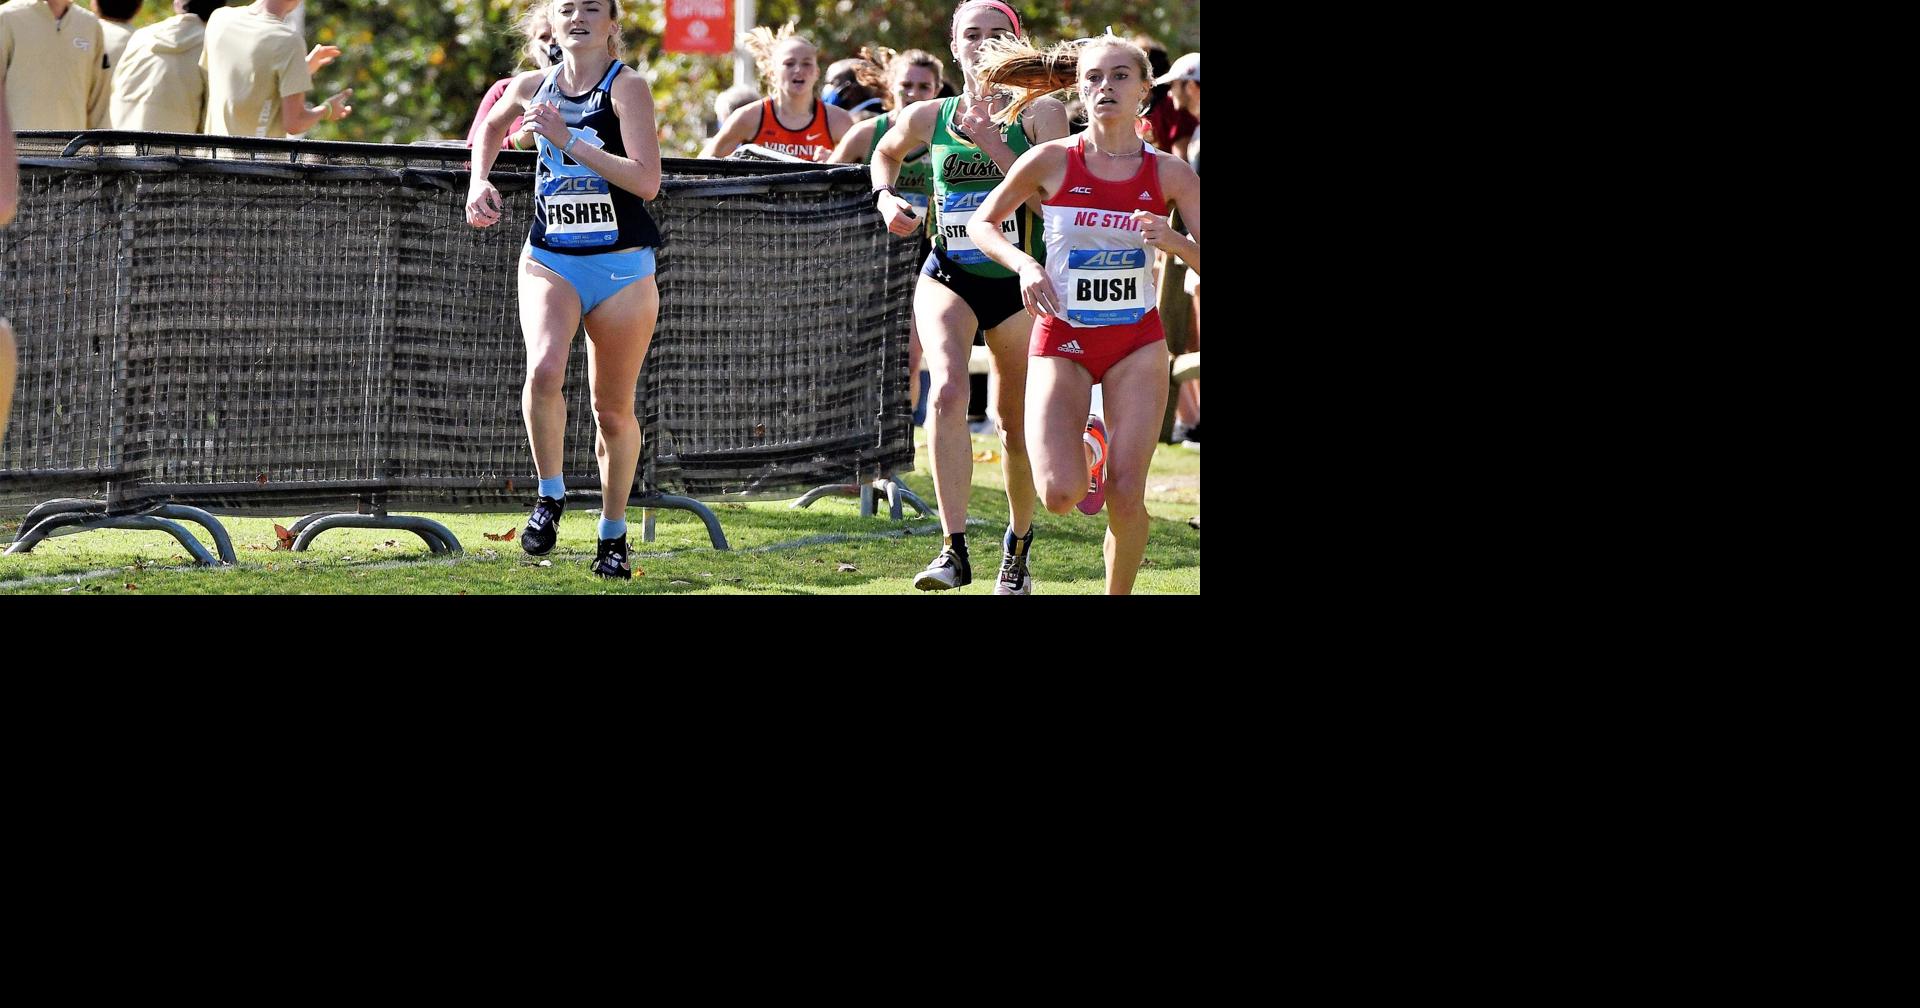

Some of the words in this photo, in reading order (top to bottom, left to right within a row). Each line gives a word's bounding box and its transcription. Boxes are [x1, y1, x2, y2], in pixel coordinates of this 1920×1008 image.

[764, 141, 816, 156] VIRGINI
[943, 153, 1004, 179] Irish
[553, 177, 600, 194] ACC
[898, 170, 926, 186] rish
[1068, 186, 1092, 194] ACC
[953, 191, 990, 208] AC
[547, 202, 615, 225] FISHER
[1074, 211, 1099, 227] NC
[1083, 249, 1138, 266] ACC
[1076, 277, 1137, 302] BUSH
